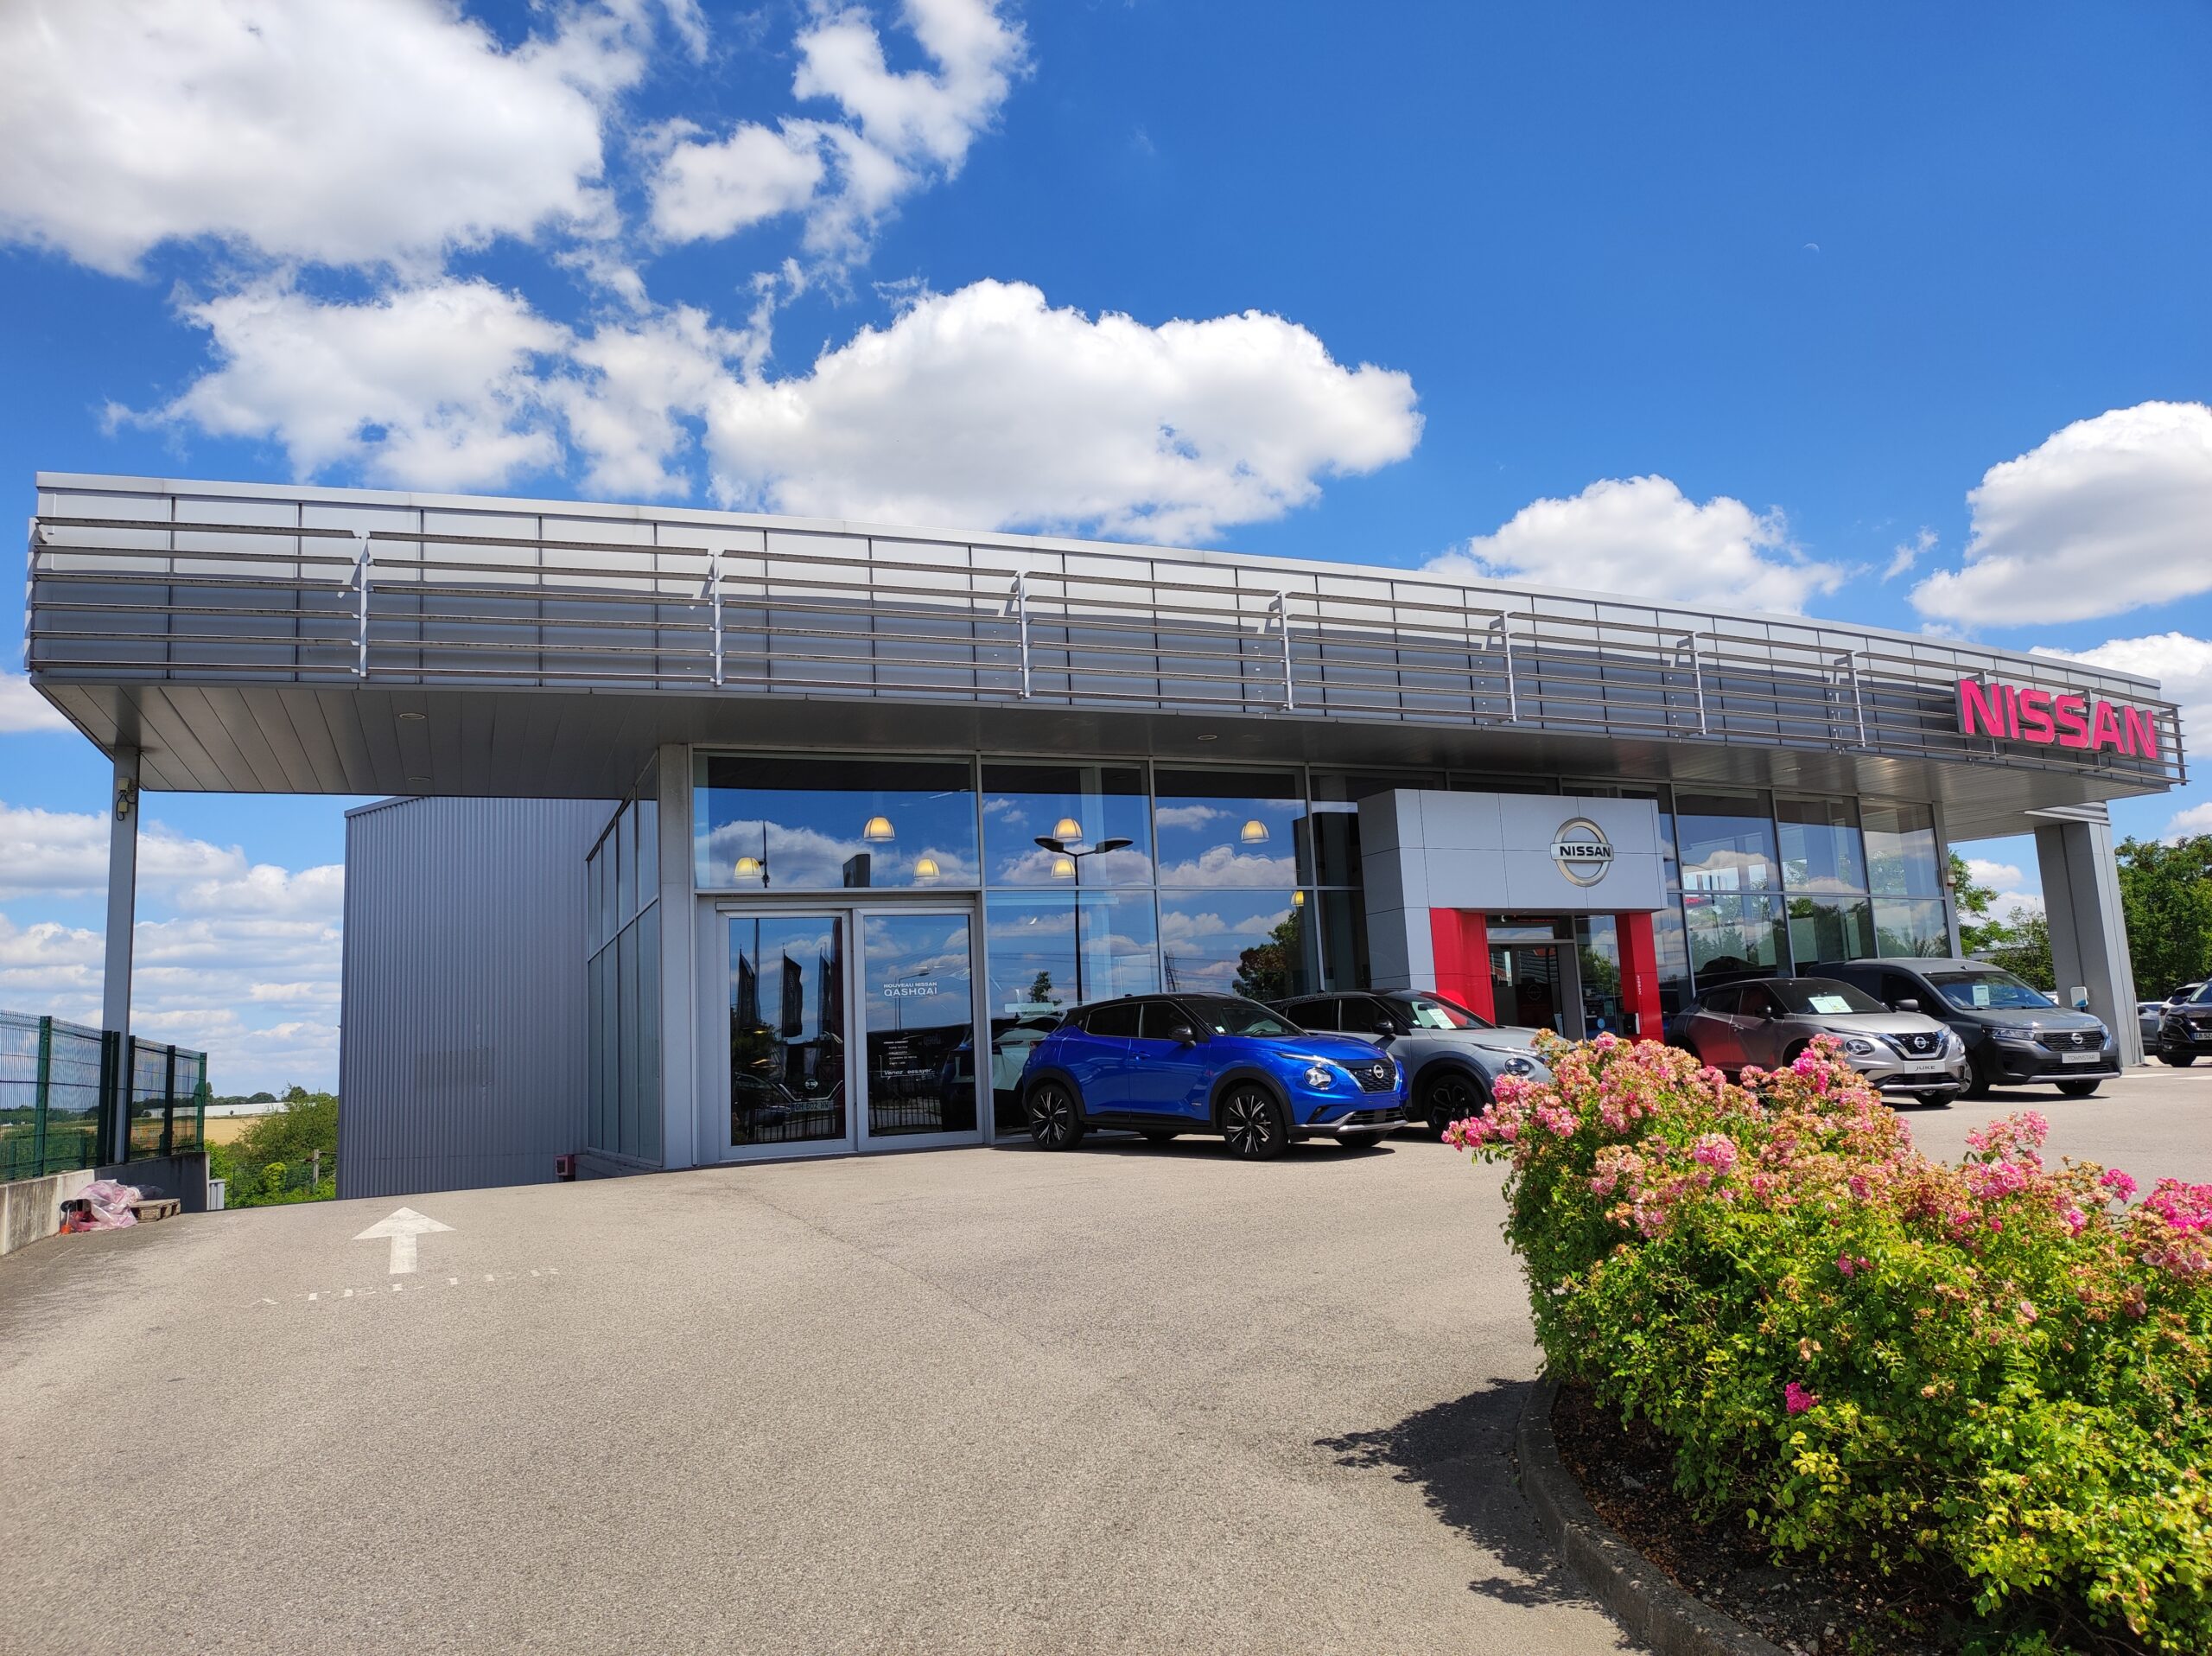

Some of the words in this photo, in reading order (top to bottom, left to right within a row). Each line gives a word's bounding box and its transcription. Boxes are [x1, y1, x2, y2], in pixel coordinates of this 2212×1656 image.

[1954, 678, 2157, 760] NISSAN
[1560, 846, 1611, 857] NISSAN
[884, 986, 938, 997] QASHQAI
